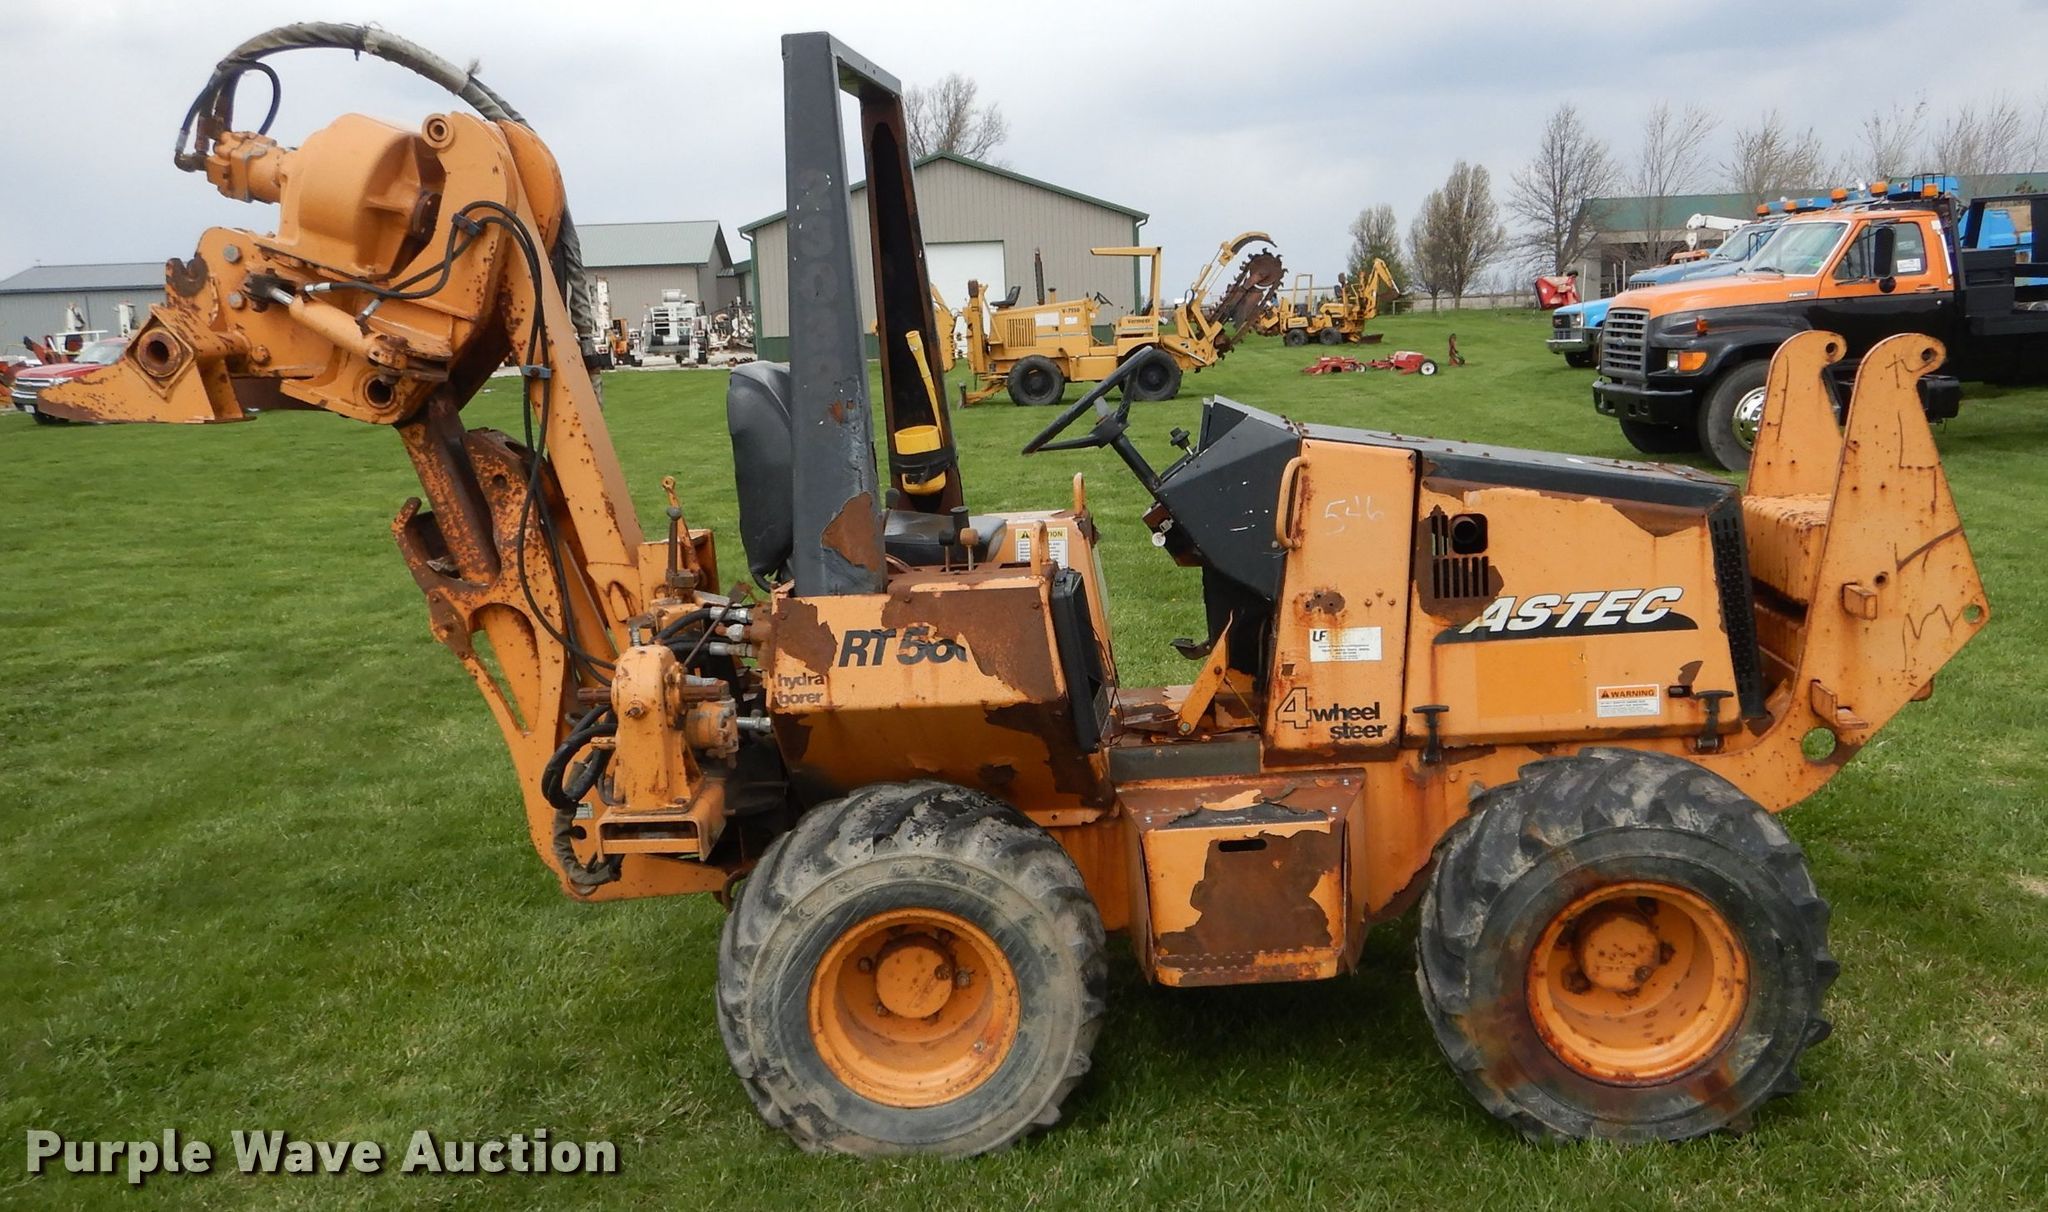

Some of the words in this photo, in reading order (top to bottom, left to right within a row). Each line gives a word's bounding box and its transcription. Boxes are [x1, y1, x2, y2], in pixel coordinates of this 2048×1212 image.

[1458, 586, 1684, 633] ASTEC
[838, 628, 896, 667] RT
[777, 672, 825, 690] hydra
[1610, 688, 1655, 698] WARNING
[1275, 686, 1312, 730] 4
[1312, 701, 1380, 722] wheel
[1329, 722, 1387, 740] steer
